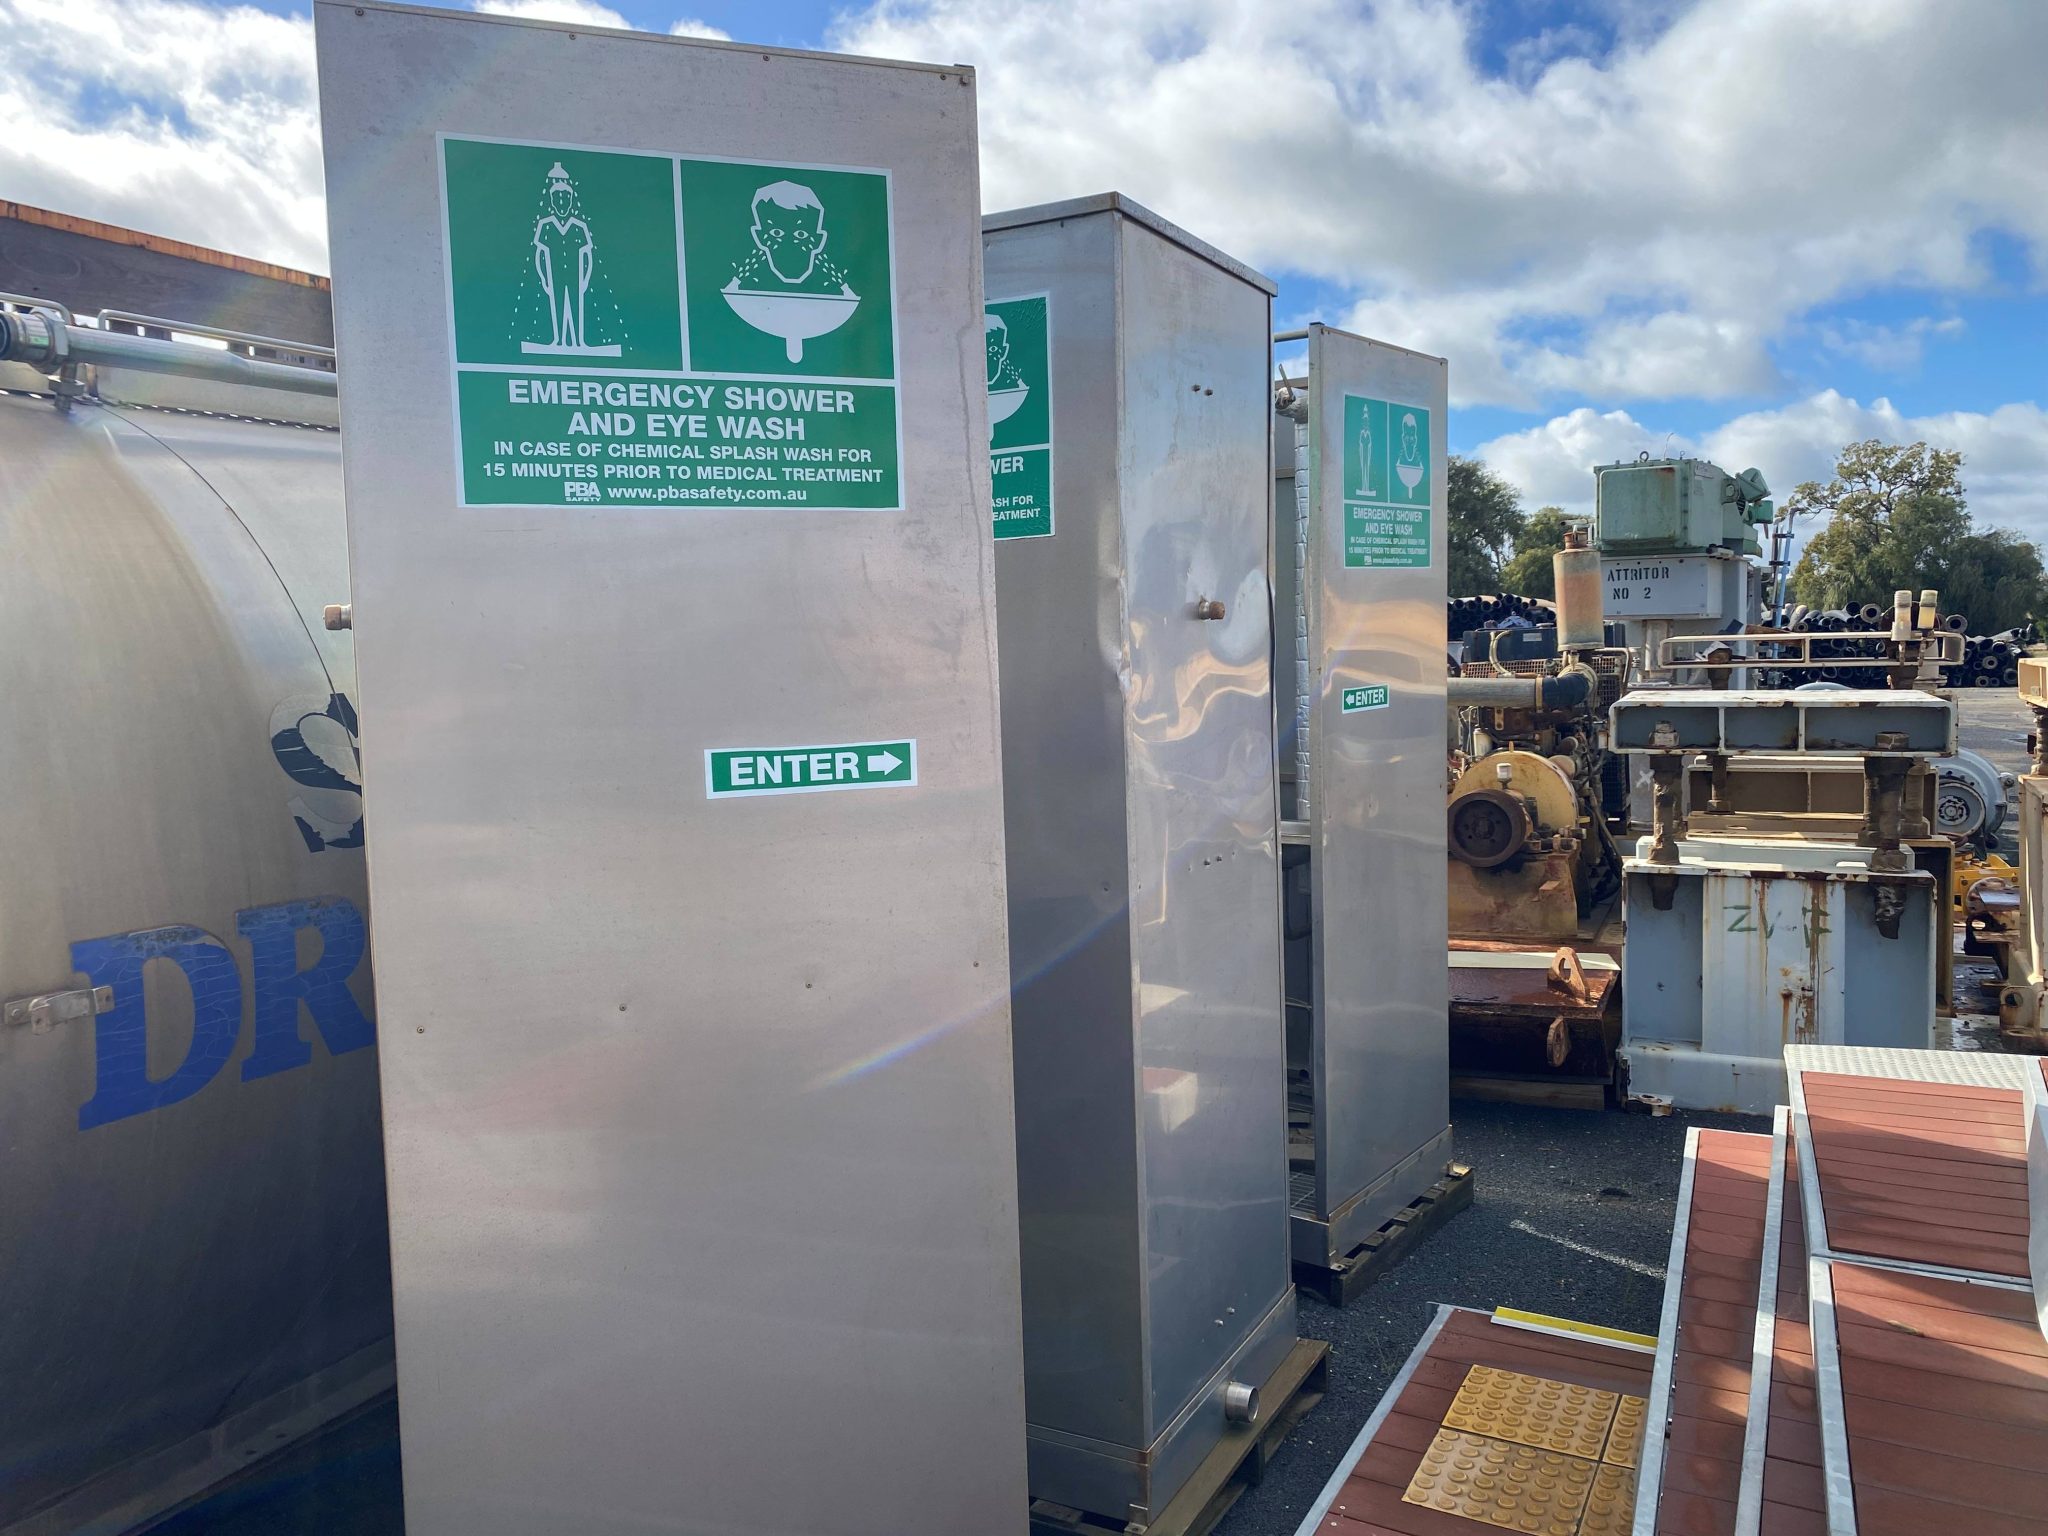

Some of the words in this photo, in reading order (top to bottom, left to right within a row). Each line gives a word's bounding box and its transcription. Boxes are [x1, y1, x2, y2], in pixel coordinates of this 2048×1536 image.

[508, 379, 715, 409] EMERGENCY
[724, 386, 855, 413] SHOWER
[567, 411, 636, 436] AND
[646, 414, 708, 438] EYE
[716, 415, 805, 441] WASH
[494, 441, 513, 456] IN
[519, 441, 571, 457] CASE
[577, 443, 602, 457] OF
[607, 443, 704, 459] CHEMICAL
[709, 445, 778, 461] SPLASH
[783, 447, 833, 462] WASH
[838, 448, 872, 463] FOR
[483, 462, 506, 477] 15
[512, 463, 598, 479] MINUTES
[604, 464, 661, 479] PRIOR
[666, 465, 691, 480] TO
[696, 466, 777, 481] MEDICAL
[782, 467, 883, 483] TREATMENT
[564, 481, 601, 497] PBA
[607, 485, 807, 503] www.pbasafety.com.au
[992, 496, 1010, 508] ASH
[1012, 495, 1034, 506] FOR
[992, 508, 1041, 521] EATMENT
[1353, 507, 1395, 521] EMERGENCY
[1396, 510, 1423, 523] SHOWER
[1364, 522, 1379, 534] AND
[1380, 523, 1394, 535] EYE
[1394, 524, 1413, 536] WASH
[1607, 566, 1670, 582] ATTRITOR
[1612, 587, 1629, 600] NO
[1643, 587, 1652, 599] 2
[1355, 688, 1385, 707] ENTER
[729, 751, 860, 786] ENTER
